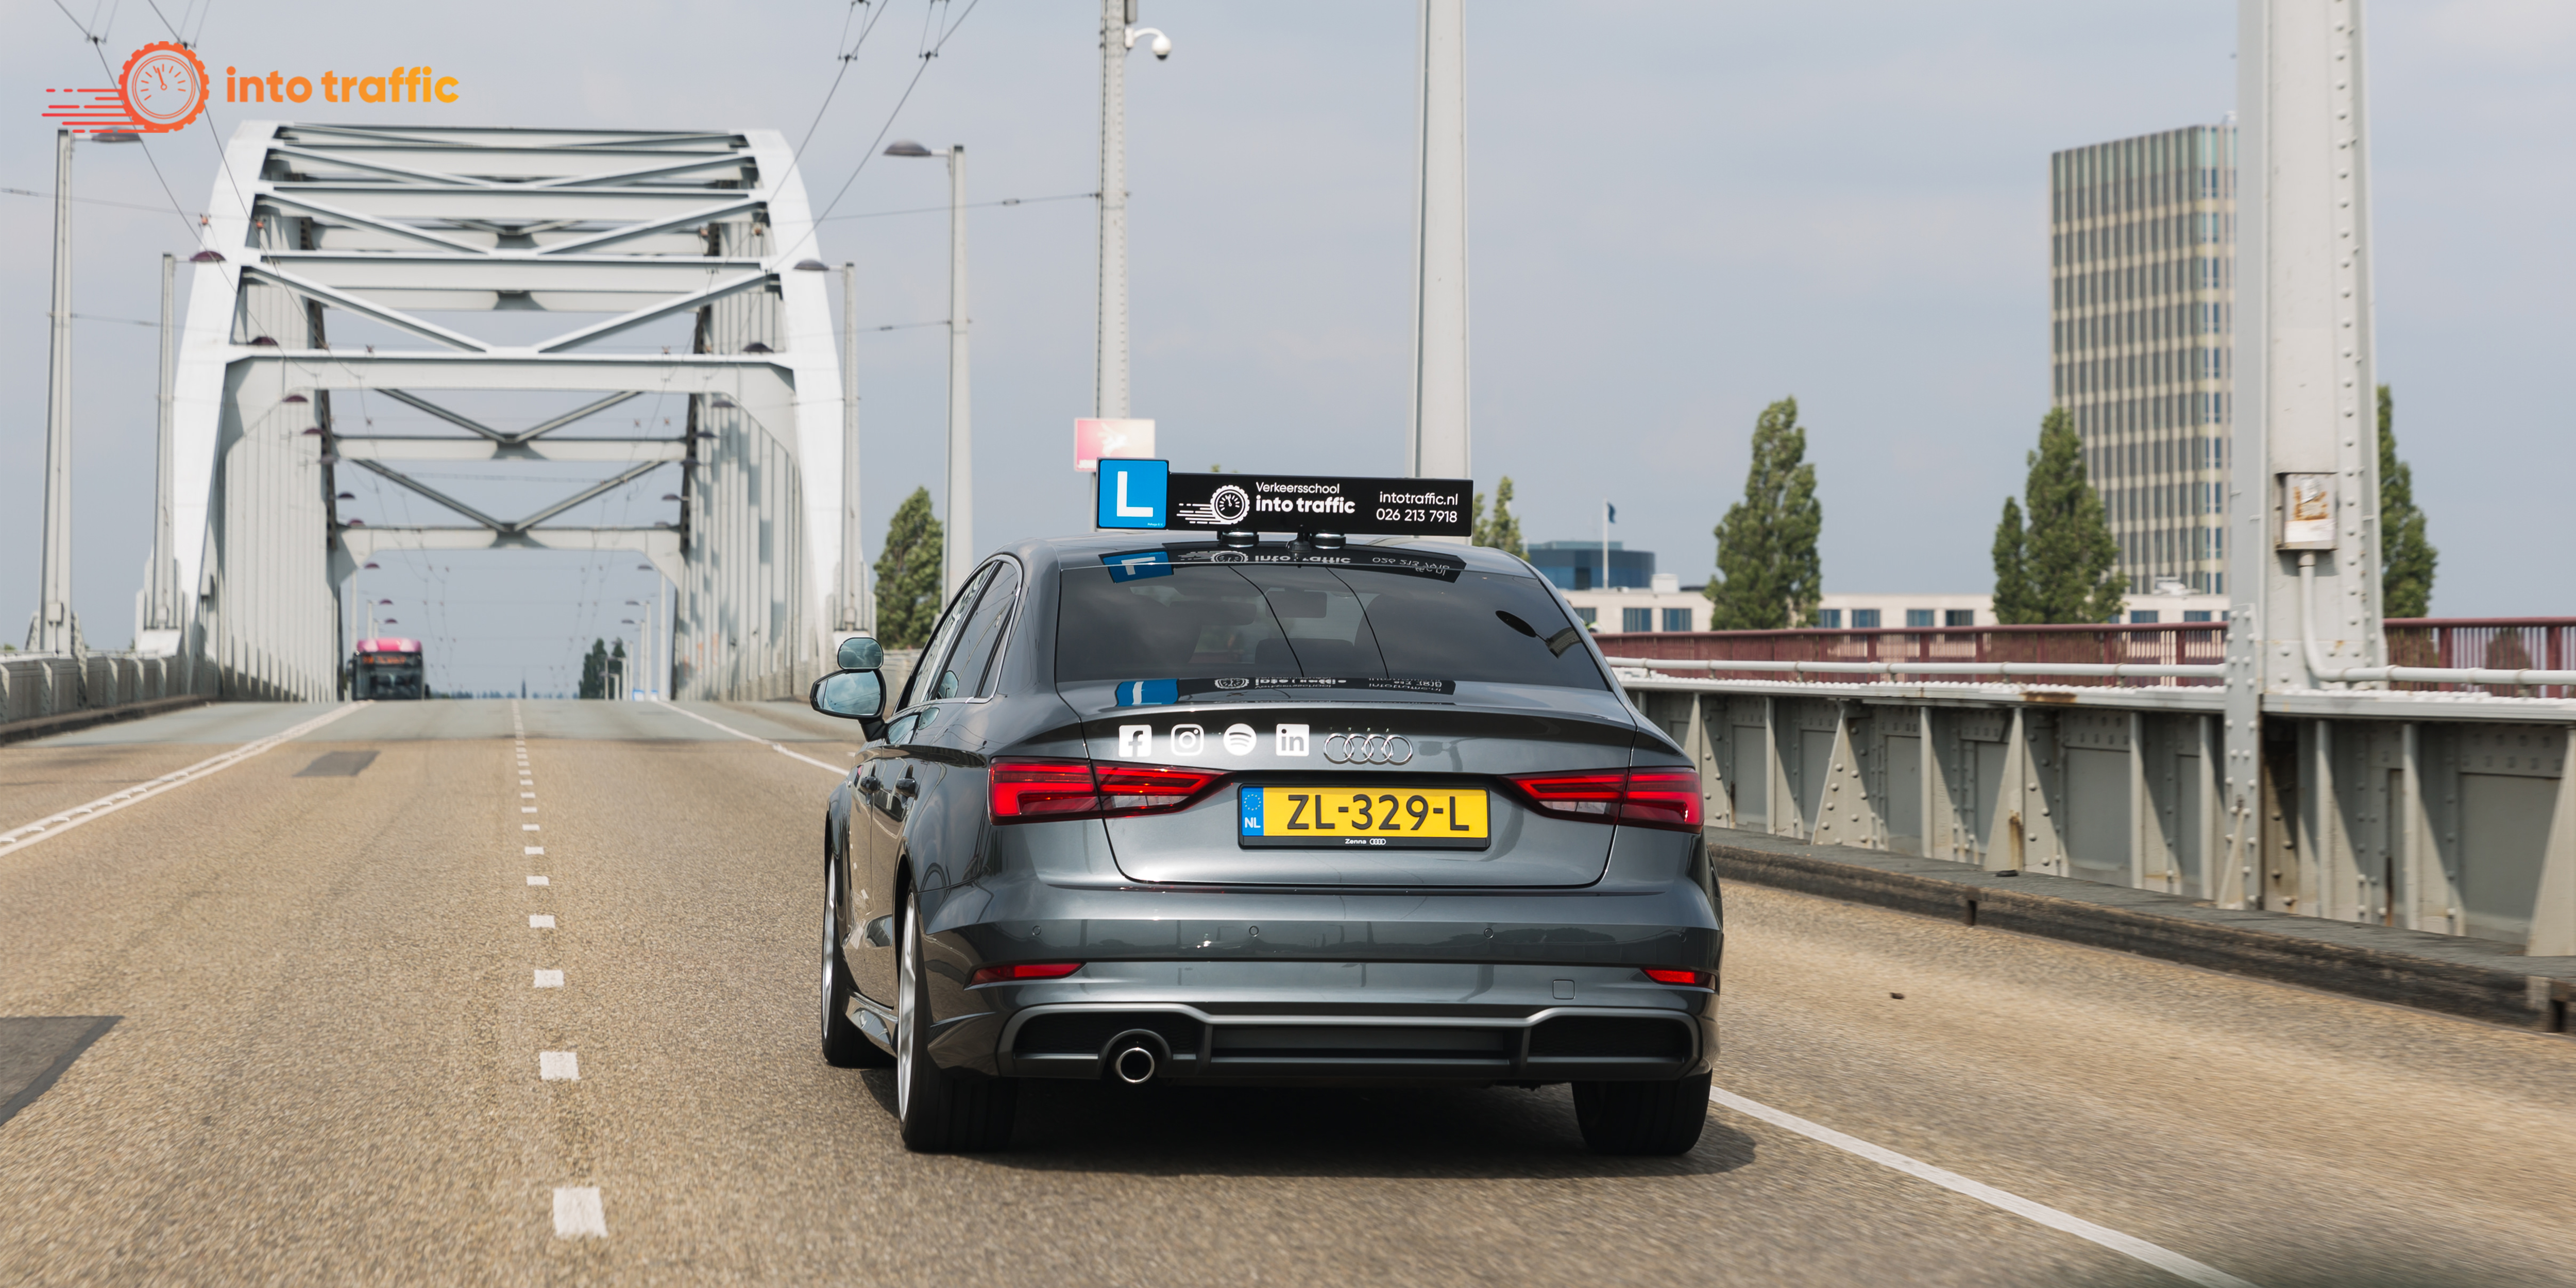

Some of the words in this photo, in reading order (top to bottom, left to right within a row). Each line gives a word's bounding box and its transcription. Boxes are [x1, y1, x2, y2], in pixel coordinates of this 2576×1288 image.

[1116, 471, 1154, 517] L
[1256, 482, 1340, 494] Verkeersschool
[1256, 495, 1294, 512] into
[1296, 496, 1355, 514] traffic
[1380, 491, 1458, 505] intotraffic.nl
[1376, 508, 1401, 521] 026
[1404, 509, 1425, 522] 213
[1429, 510, 1458, 523] 7918
[1287, 794, 1469, 831] ZL-329-L
[1244, 817, 1261, 828] NL
